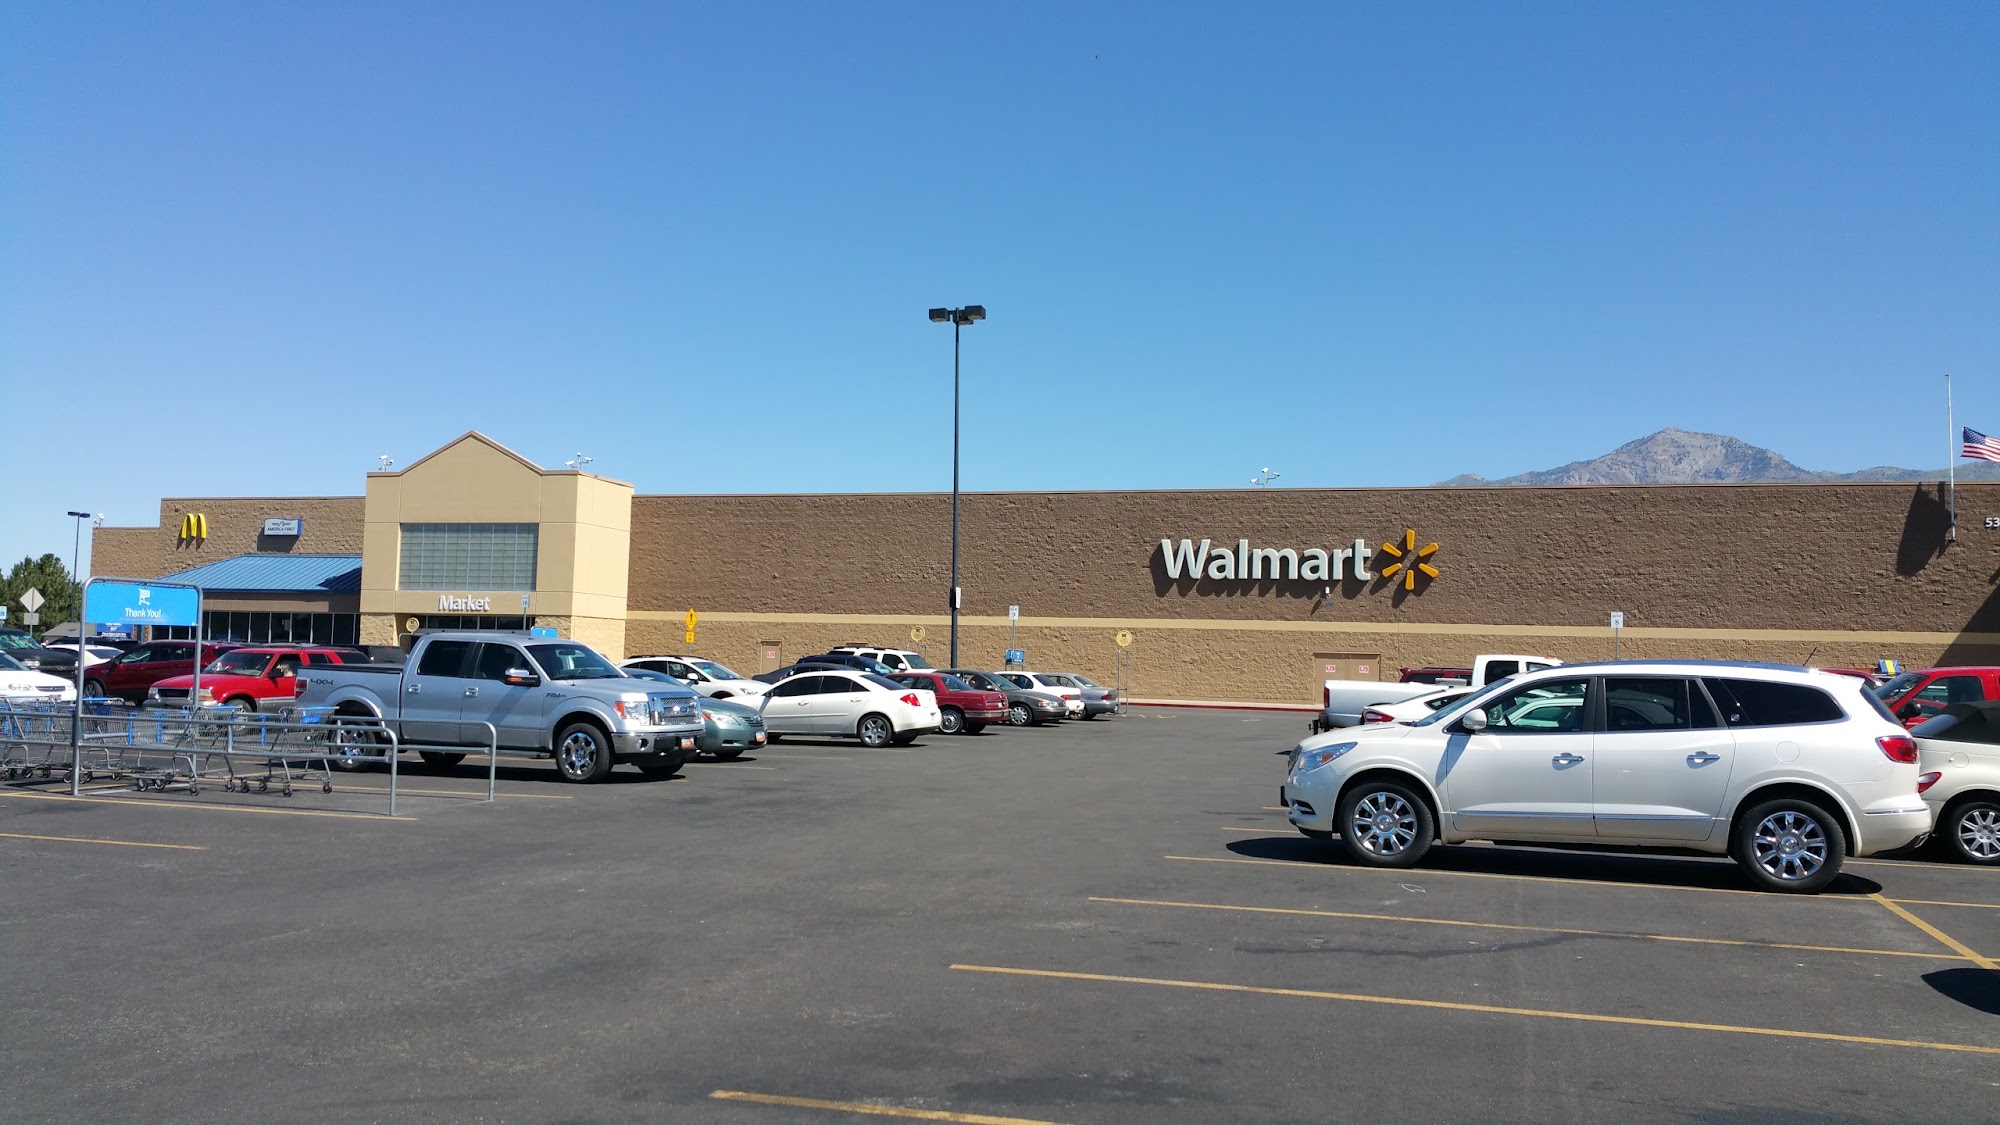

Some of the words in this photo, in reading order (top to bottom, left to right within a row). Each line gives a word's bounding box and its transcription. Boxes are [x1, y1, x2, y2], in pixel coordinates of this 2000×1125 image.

[1161, 539, 1371, 581] Walmart
[439, 594, 490, 612] Market
[125, 608, 146, 617] Thank
[147, 609, 162, 617] You!
